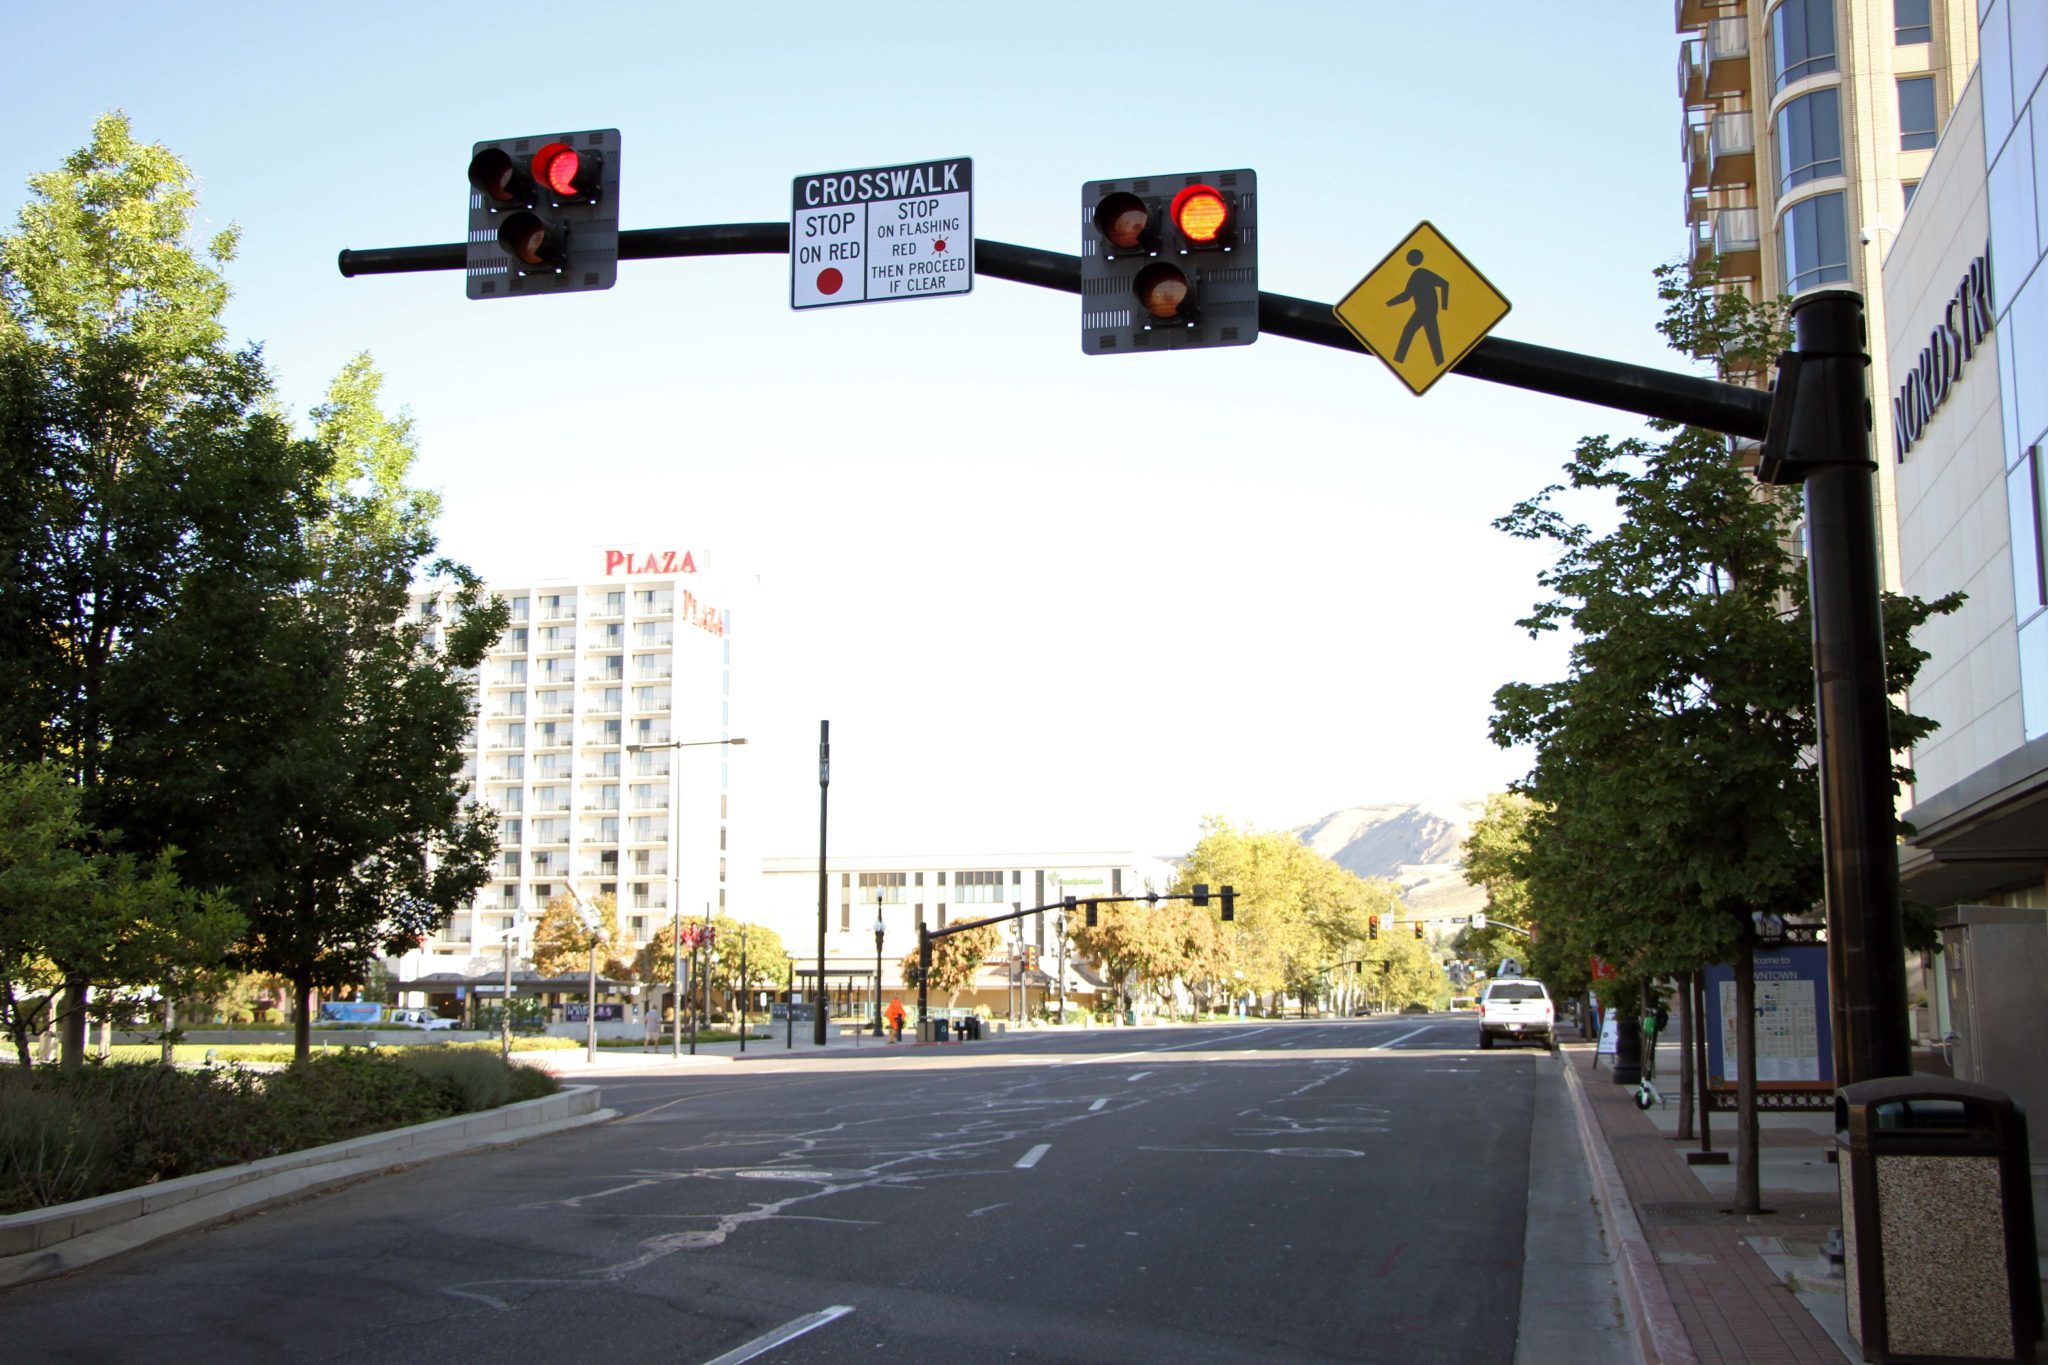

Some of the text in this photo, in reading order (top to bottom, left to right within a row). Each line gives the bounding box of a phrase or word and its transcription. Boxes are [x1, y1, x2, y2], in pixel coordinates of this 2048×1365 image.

[805, 163, 959, 206] CROSSWALK
[898, 199, 939, 220] STOP
[805, 212, 855, 238] STOP
[878, 218, 959, 239] ON FLASHING
[800, 241, 860, 264] ON RED
[892, 242, 917, 257] RED
[871, 258, 966, 279] THEN PROCEED
[889, 276, 946, 293] IF CLEAR
[605, 549, 697, 576] PLAZA
